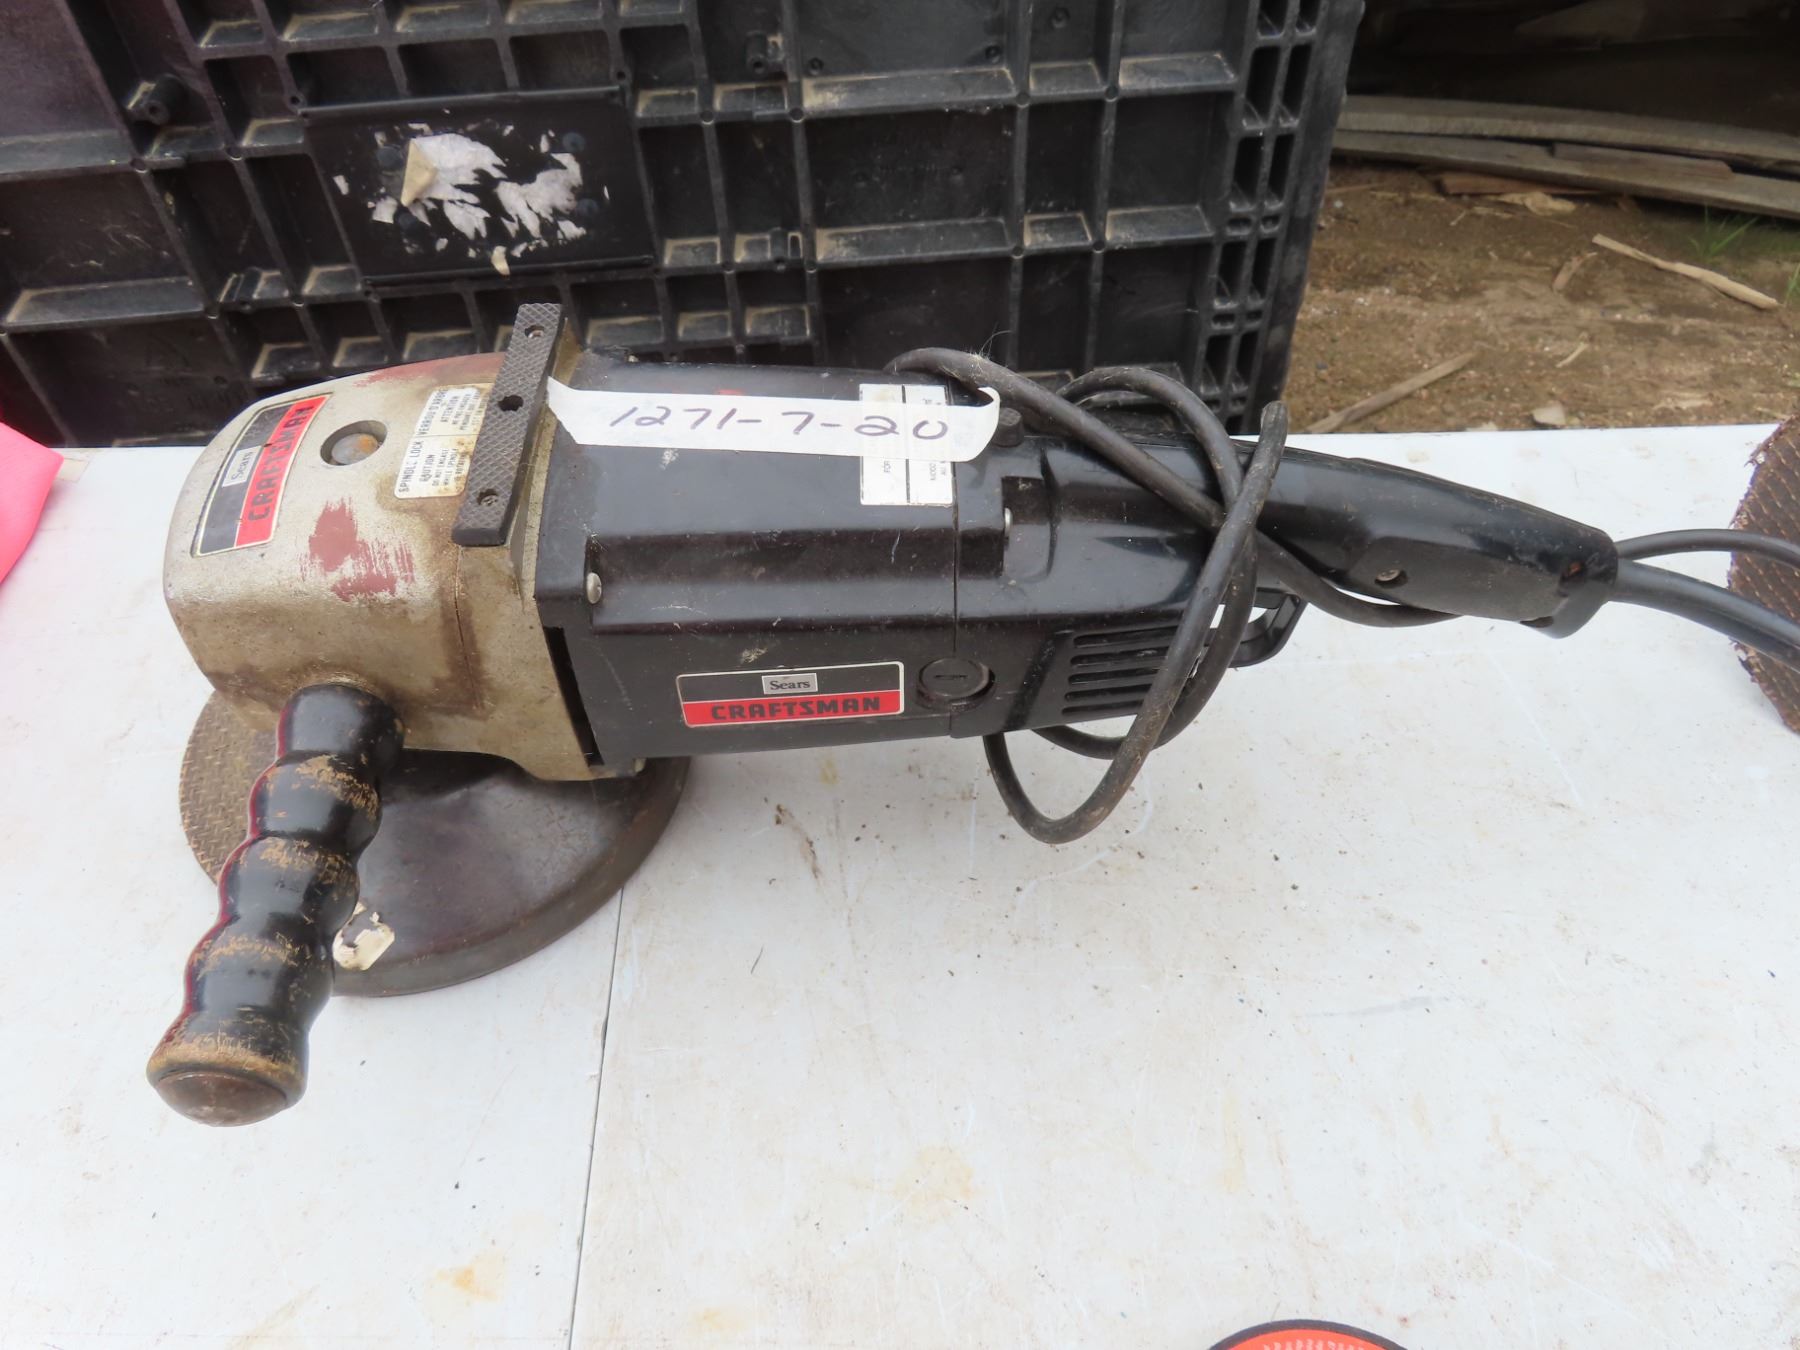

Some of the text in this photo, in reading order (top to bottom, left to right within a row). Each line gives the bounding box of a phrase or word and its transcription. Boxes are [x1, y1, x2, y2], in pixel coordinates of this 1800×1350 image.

[610, 406, 949, 440] 1271-7-20
[409, 440, 425, 458] LOCK
[231, 451, 253, 481] Sears
[248, 405, 315, 522] CRAFTSMAN
[769, 680, 812, 691] Sears
[711, 696, 881, 721] CRAFTSMAN
